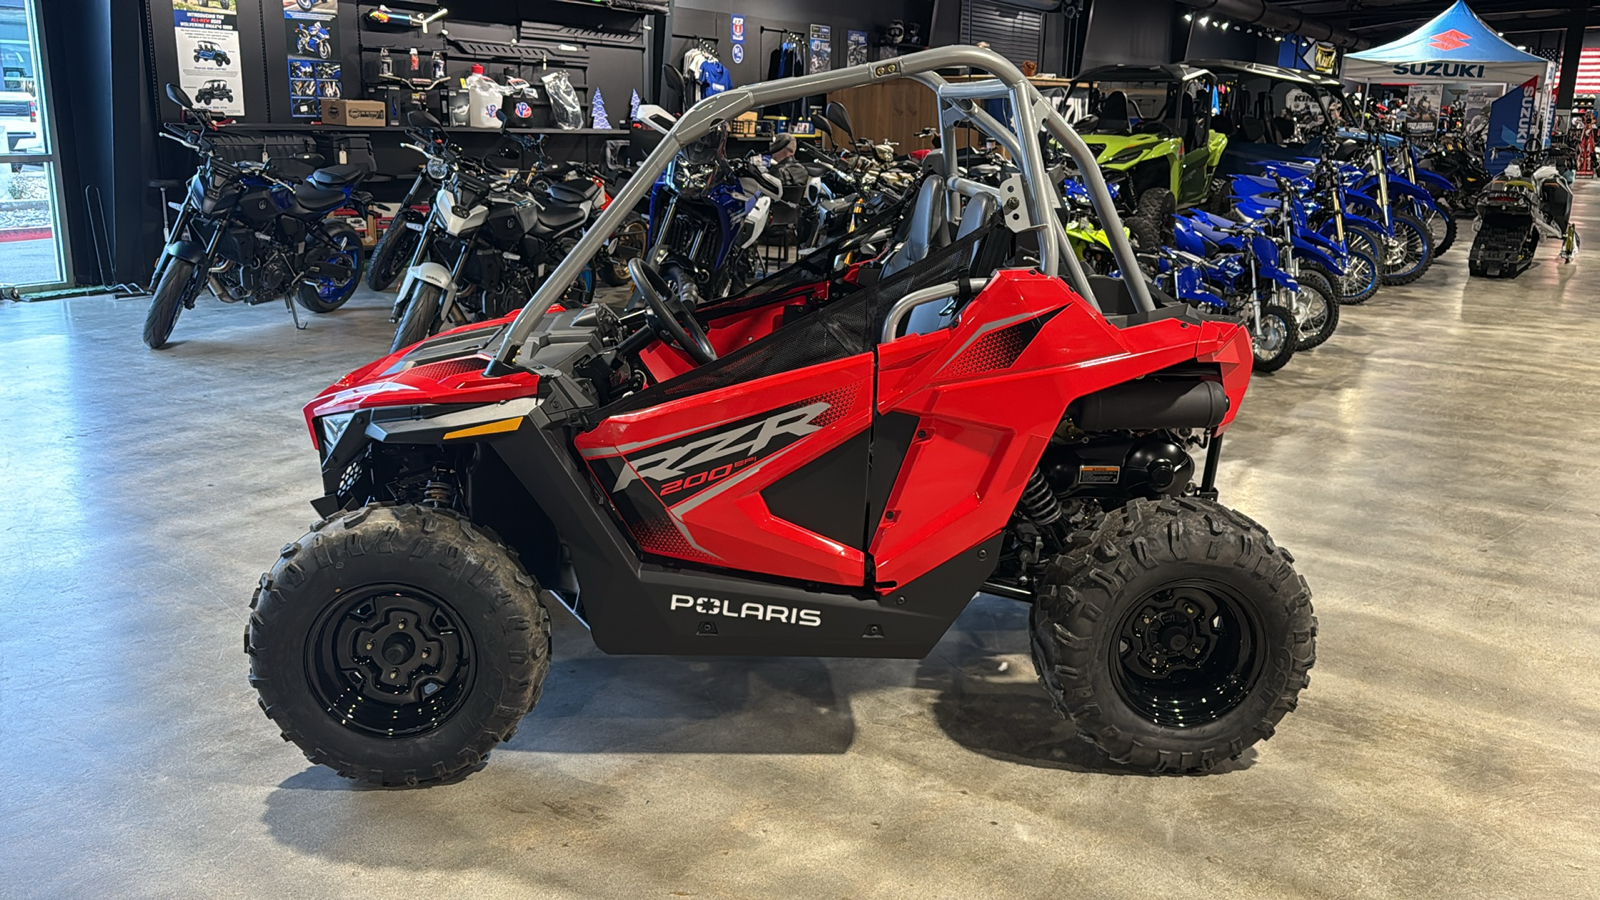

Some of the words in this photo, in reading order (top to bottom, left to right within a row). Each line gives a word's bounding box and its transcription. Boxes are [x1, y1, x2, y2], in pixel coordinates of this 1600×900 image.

[1393, 62, 1484, 79] SUZUKI
[516, 102, 528, 117] VP
[1516, 85, 1535, 144] SUZUKI
[612, 402, 832, 493] RZR
[659, 463, 733, 496] 200
[670, 594, 822, 627] POLARIS
